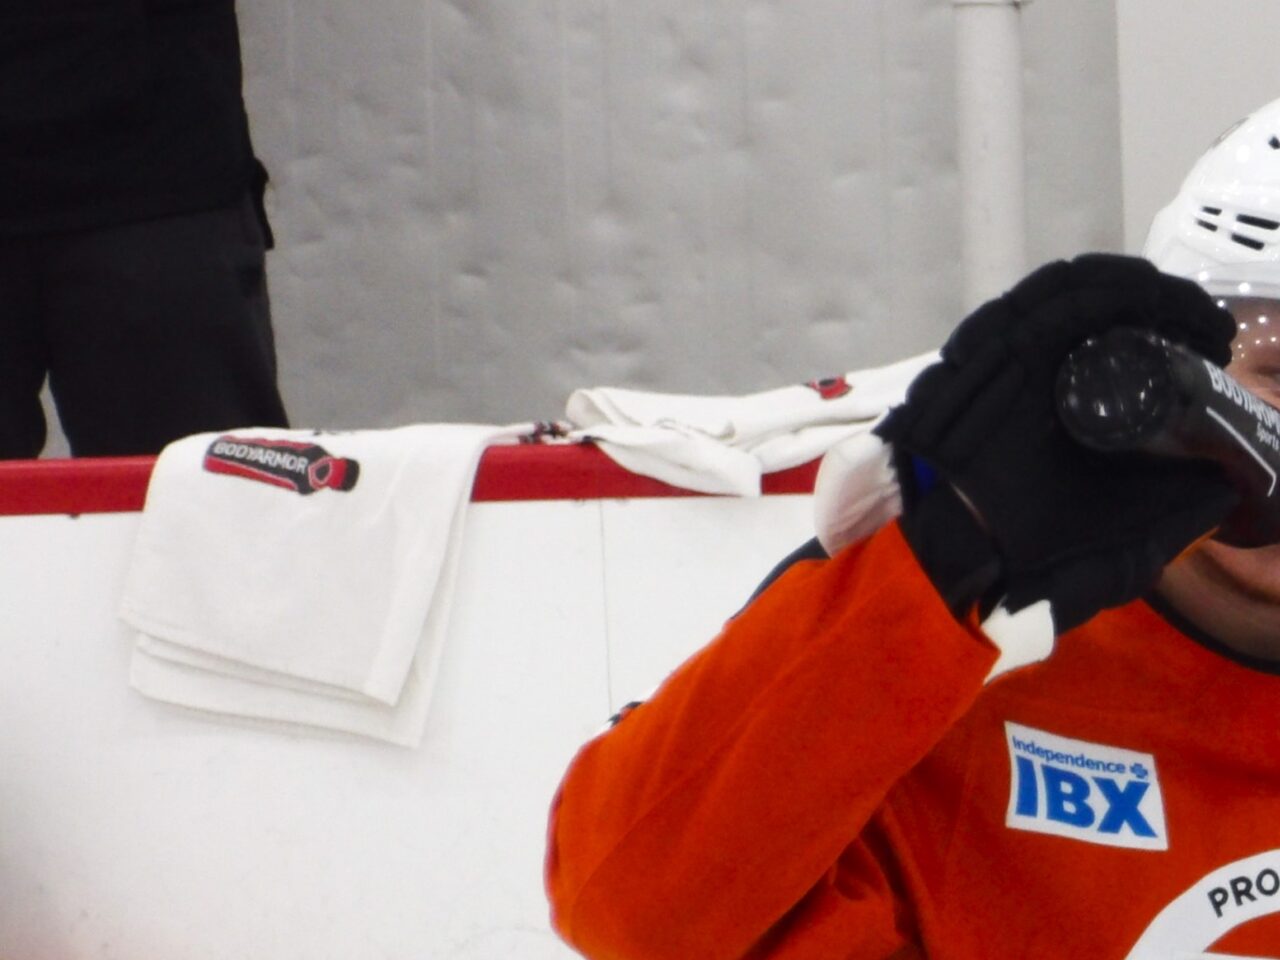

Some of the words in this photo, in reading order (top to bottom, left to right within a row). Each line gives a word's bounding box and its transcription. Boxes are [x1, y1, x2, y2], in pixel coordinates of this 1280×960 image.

[213, 440, 309, 474] BODYARMOR
[1012, 735, 1126, 774] Independence
[1015, 755, 1159, 838] IBX
